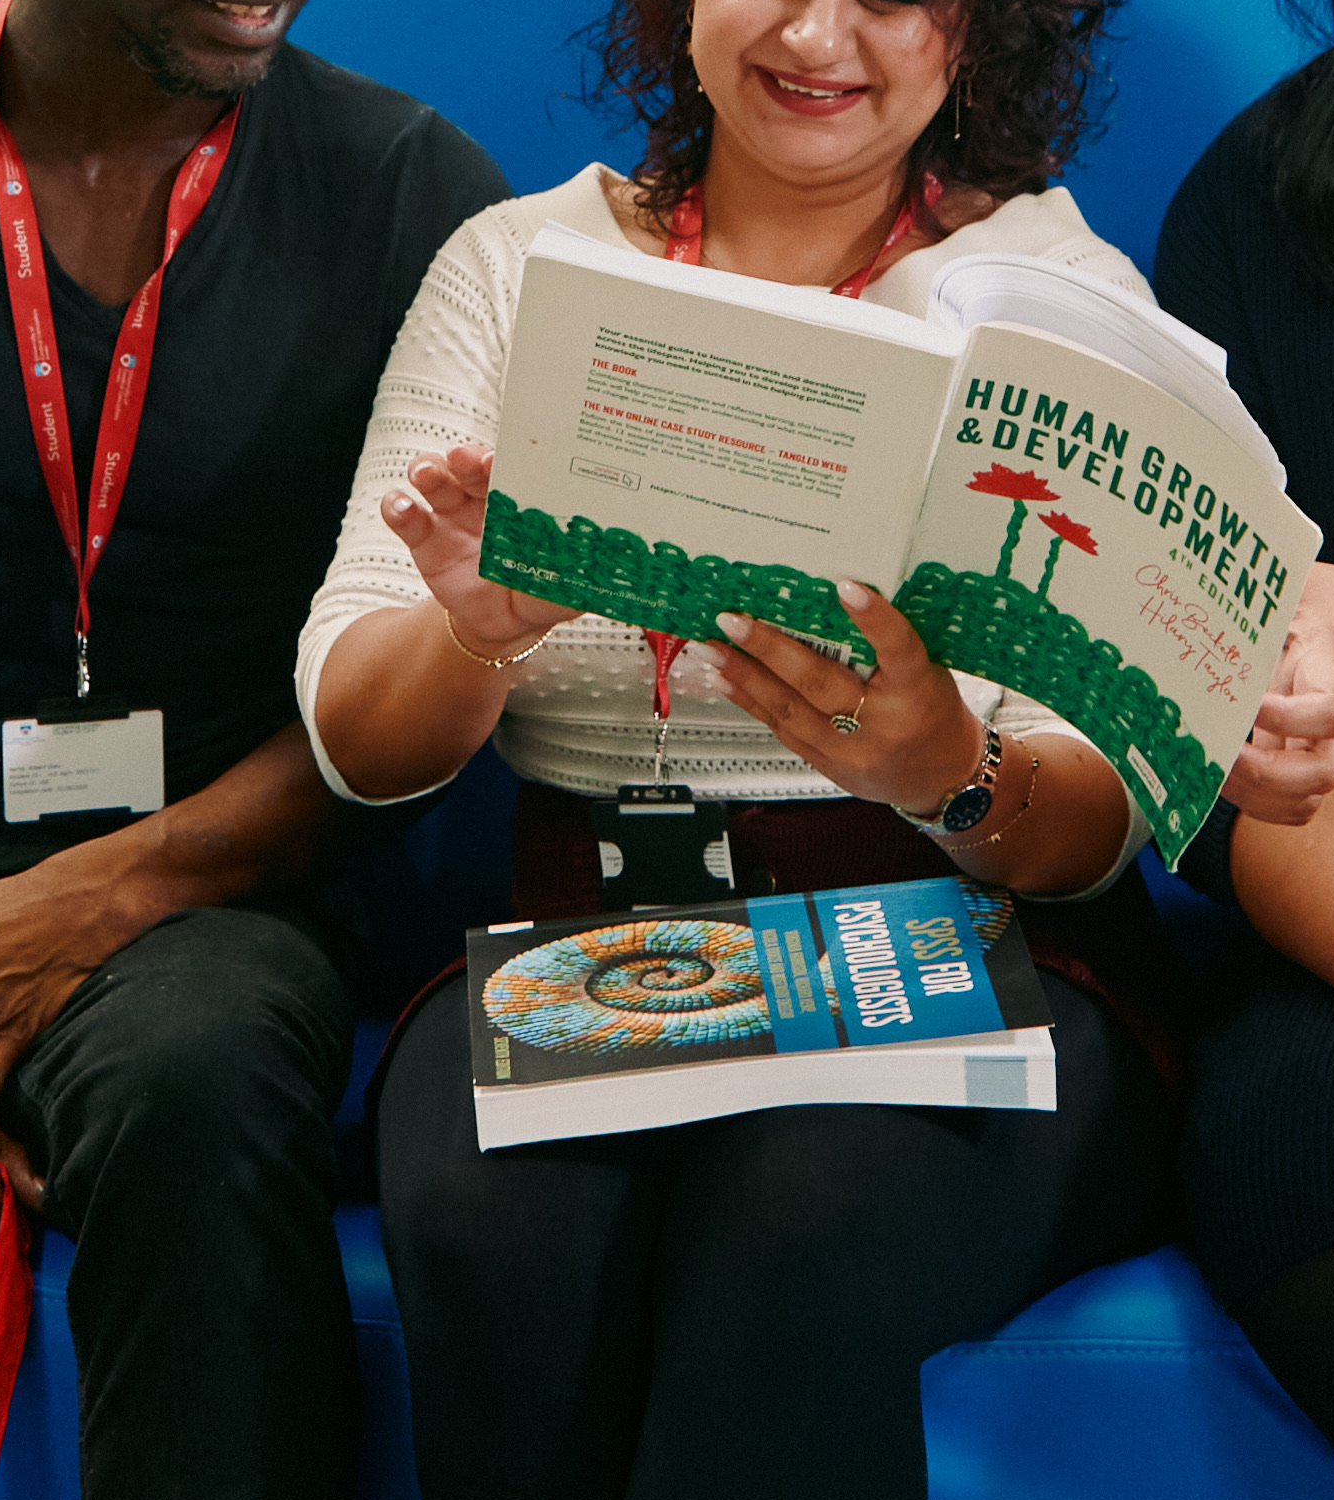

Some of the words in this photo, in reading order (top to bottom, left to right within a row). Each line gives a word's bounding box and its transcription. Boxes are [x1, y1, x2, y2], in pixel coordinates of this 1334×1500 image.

[13, 219, 32, 279] Student
[592, 358, 609, 369] THE
[612, 364, 637, 376] BOOK
[42, 401, 60, 462] Student
[584, 401, 600, 411] THE
[603, 406, 624, 417] NEW
[625, 412, 659, 426] ONLINE
[660, 421, 684, 433] CASE
[687, 427, 716, 440] STUDY
[719, 436, 765, 453] RESOURCE
[778, 450, 819, 466] TANGLED
[821, 461, 847, 473] WEBS
[98, 452, 120, 509] Student
[965, 378, 1129, 459] HUMAN
[1141, 446, 1288, 599] GROWTH
[517, 562, 560, 583] SAGE
[1168, 548, 1194, 572] 4TH
[1198, 574, 1259, 645] EDITION
[1135, 564, 1182, 607] Chris
[1182, 602, 1242, 667] Beckett
[1237, 663, 1253, 682] &
[1139, 595, 1196, 661] Hilary
[1194, 640, 1240, 704] Taylor
[833, 900, 914, 1028] PSYCHOLOGISTS
[904, 916, 964, 960] SPSS
[917, 960, 974, 996] FOR
